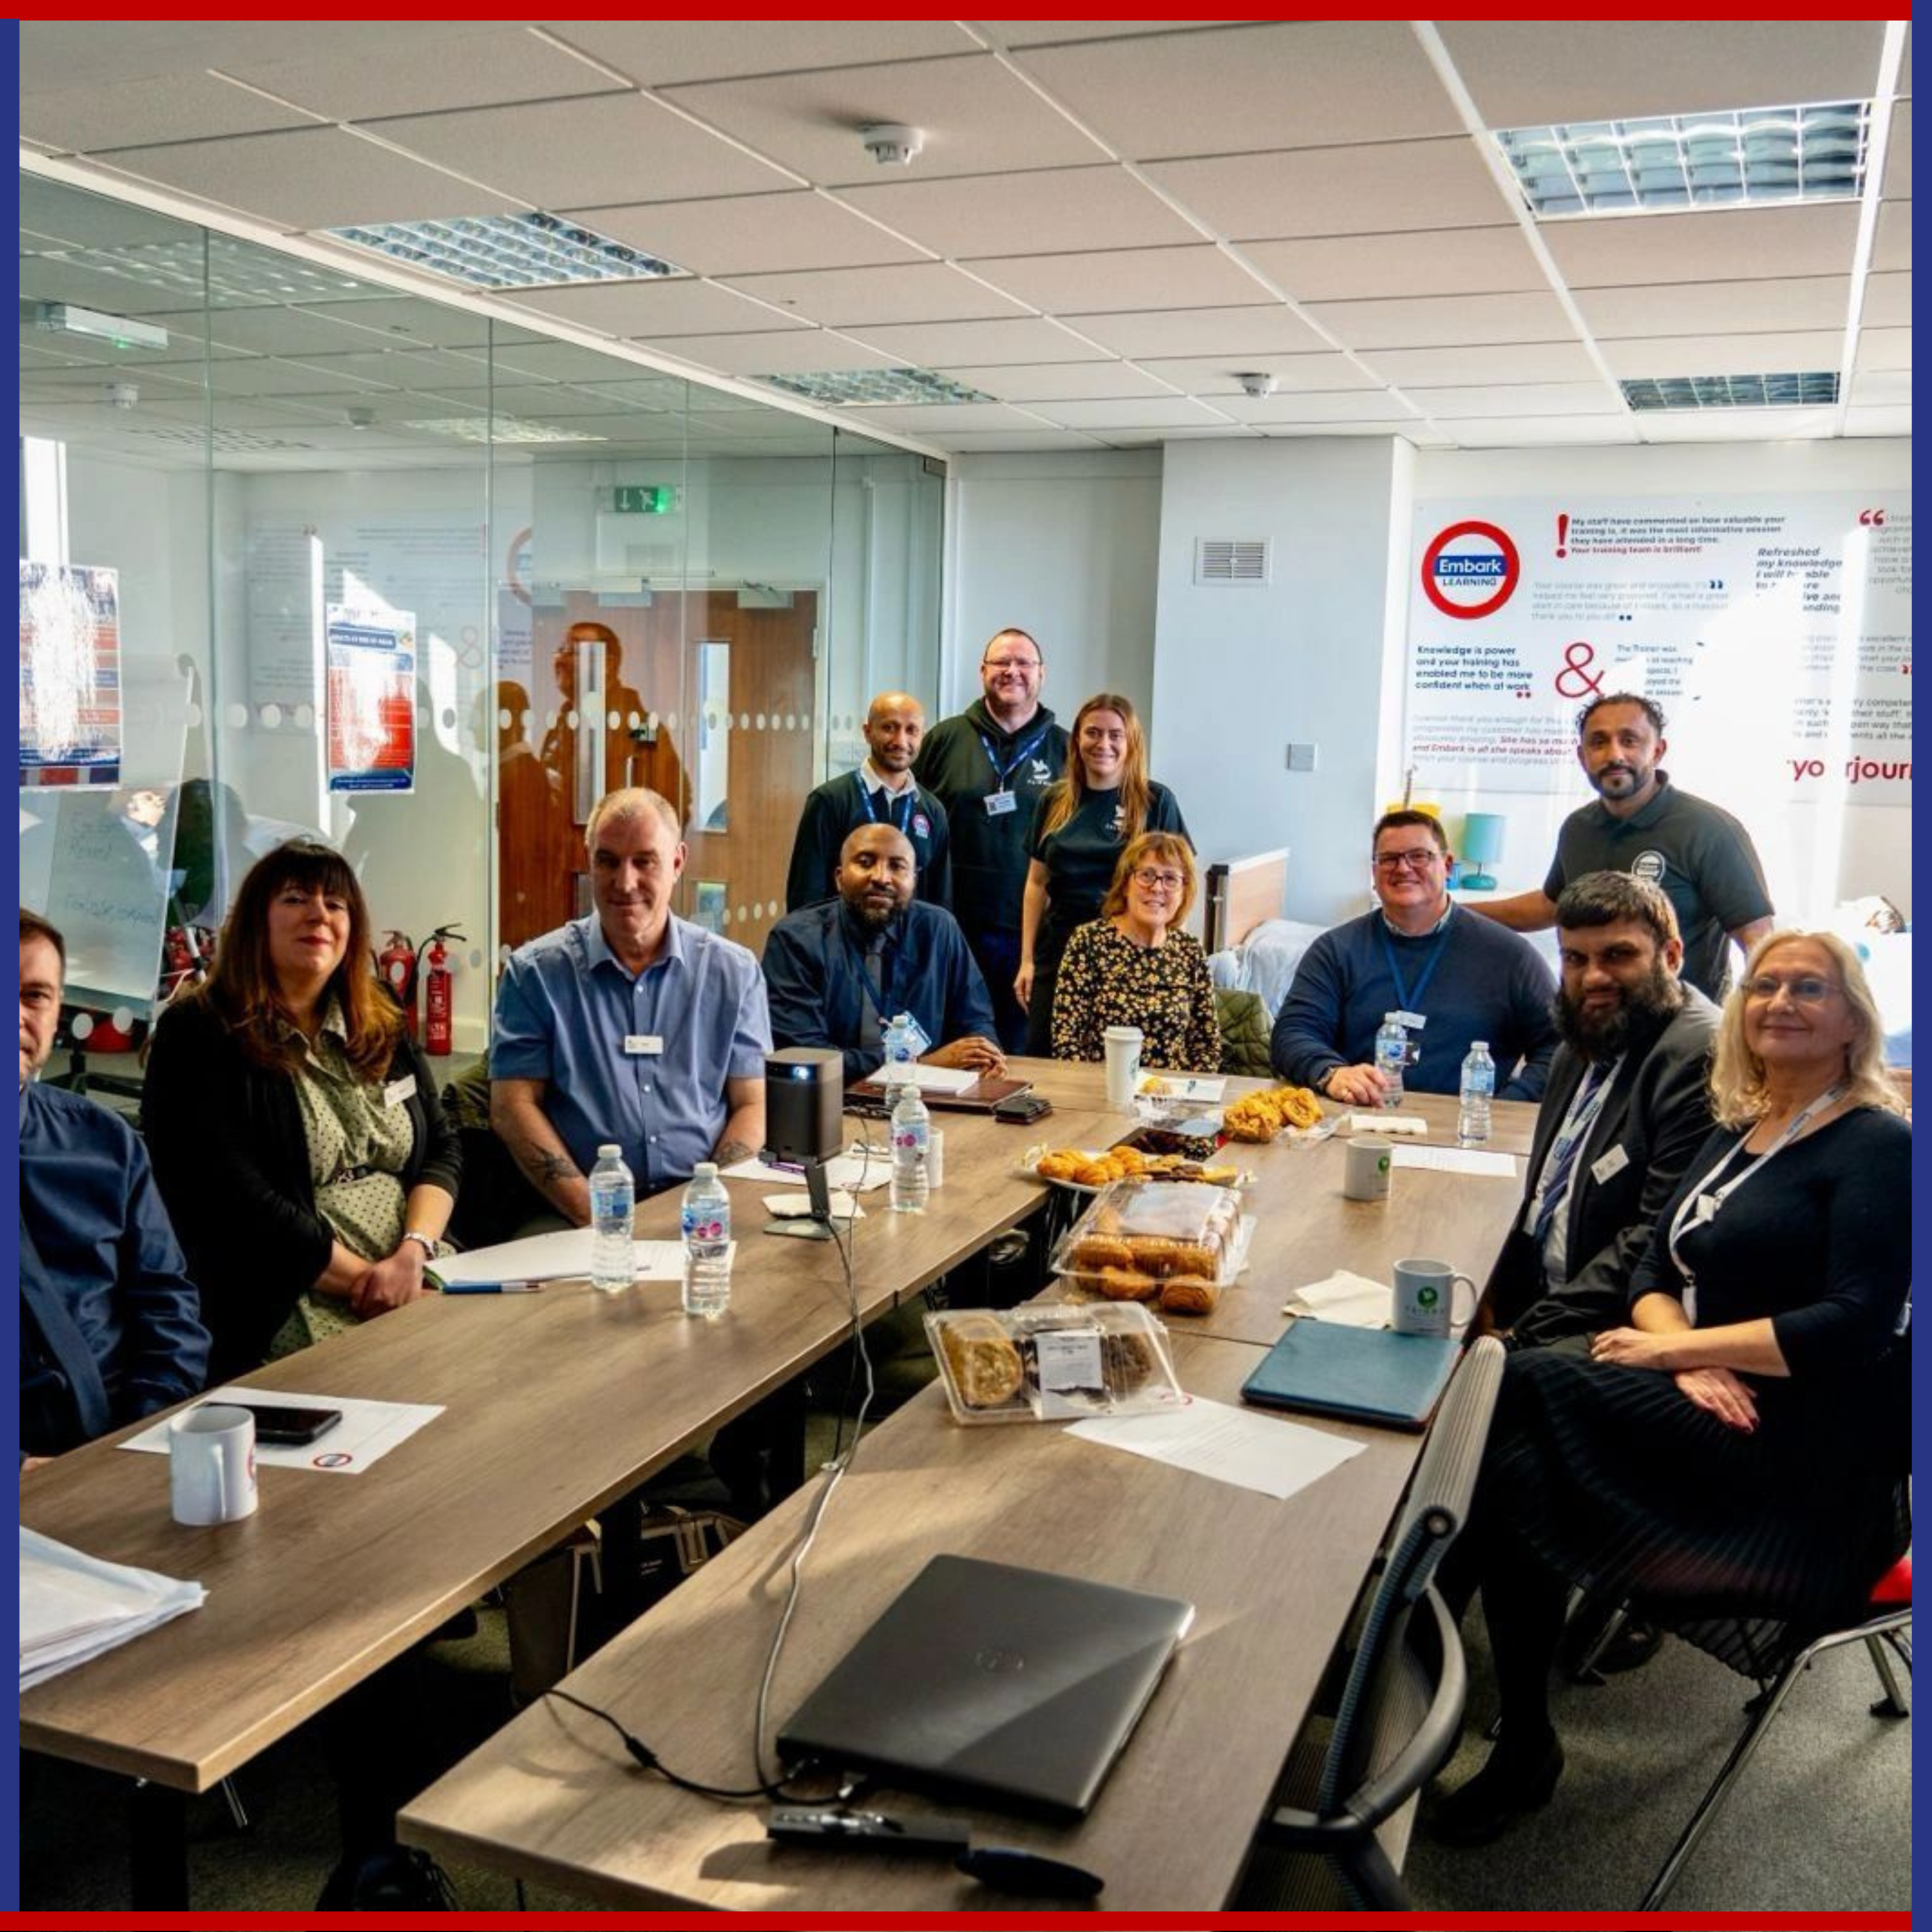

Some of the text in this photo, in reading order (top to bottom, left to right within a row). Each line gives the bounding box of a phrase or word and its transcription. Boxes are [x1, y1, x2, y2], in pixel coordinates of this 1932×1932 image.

[1571, 527, 1605, 535] training
[1593, 547, 1627, 555] training
[1758, 547, 1820, 556] Refreshed
[1439, 558, 1502, 574] Embark
[1756, 559, 1843, 569] my knowledge
[1763, 570, 1784, 578] will
[1443, 578, 1496, 586] LEARNING
[1418, 646, 1471, 655] Knowledge
[1484, 647, 1516, 655] power
[1463, 659, 1500, 668] training
[1502, 659, 1520, 667] has
[1416, 670, 1457, 678] enabled
[1491, 670, 1504, 678] be
[1506, 671, 1533, 679] more
[1415, 681, 1462, 689] confident
[1464, 682, 1491, 690] when
[1494, 682, 1503, 690] at
